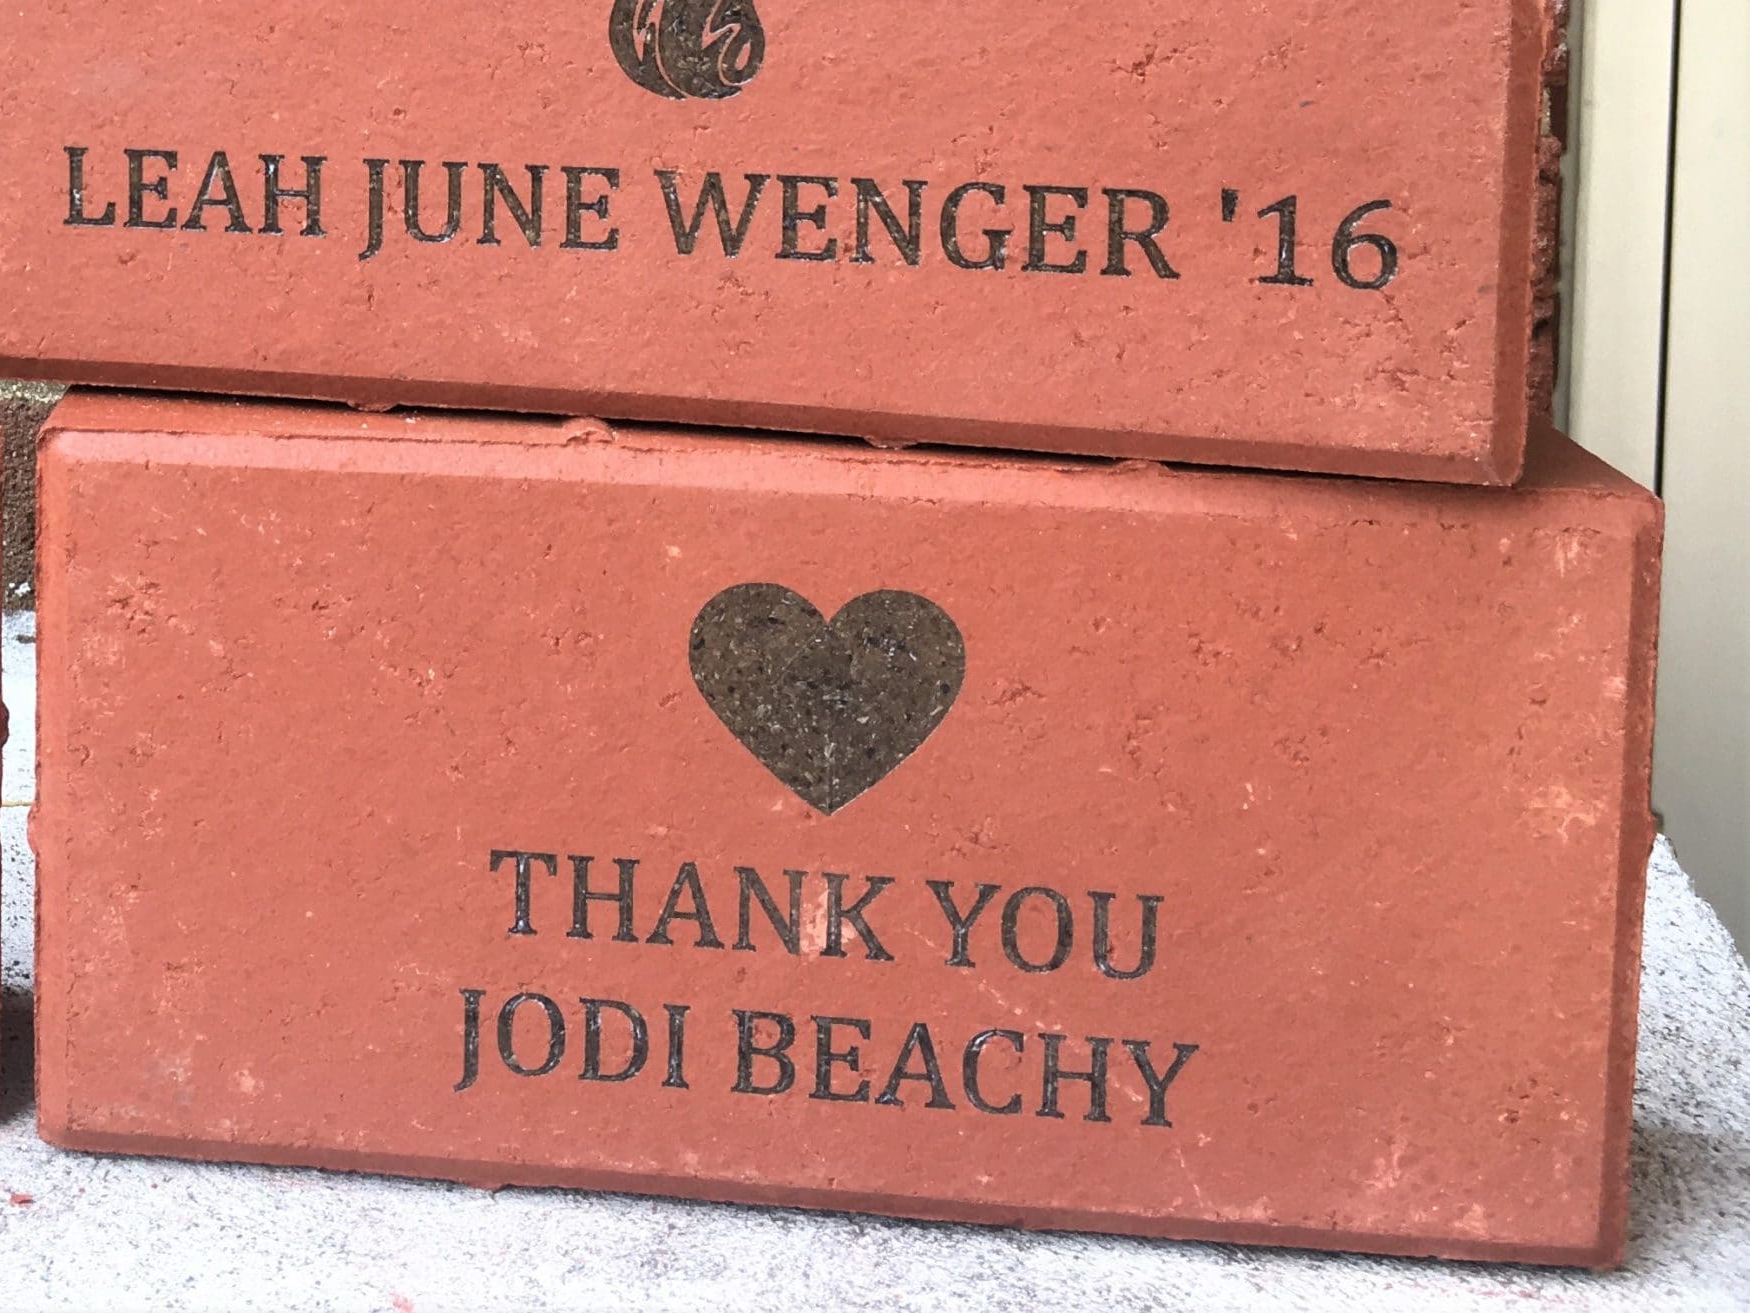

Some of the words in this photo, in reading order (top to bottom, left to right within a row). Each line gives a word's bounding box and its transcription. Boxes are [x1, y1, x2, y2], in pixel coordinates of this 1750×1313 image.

[63, 145, 328, 237] LEAH
[358, 157, 620, 261] JUNE
[654, 169, 1182, 280] WENGER
[1220, 188, 1399, 291] '16
[490, 848, 895, 963] THANK
[926, 878, 1165, 981] YOU
[455, 987, 691, 1092] JODI
[731, 1008, 1201, 1129] BEACHY
